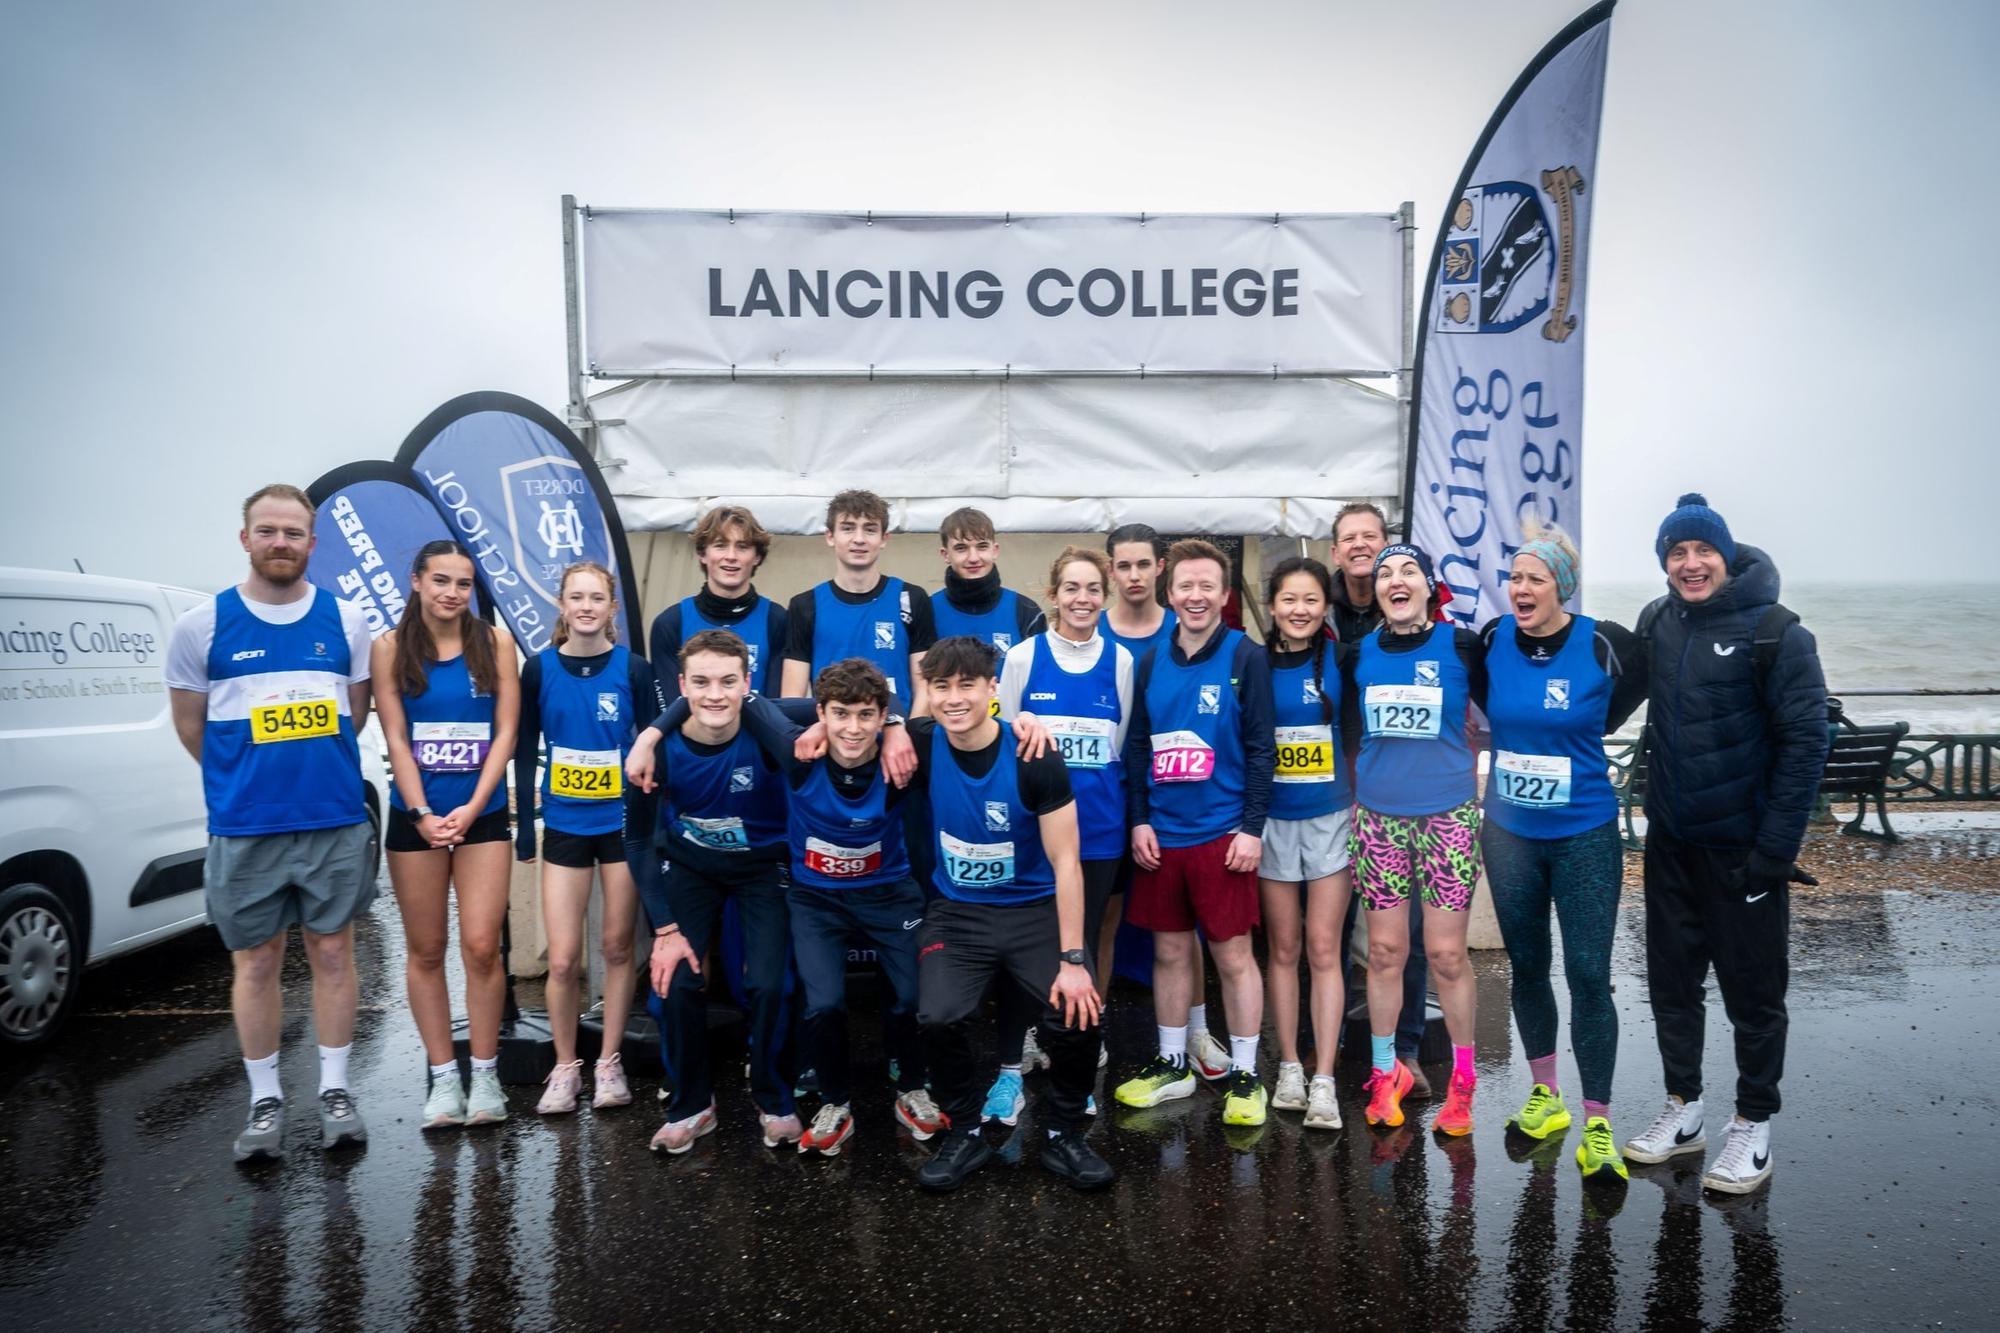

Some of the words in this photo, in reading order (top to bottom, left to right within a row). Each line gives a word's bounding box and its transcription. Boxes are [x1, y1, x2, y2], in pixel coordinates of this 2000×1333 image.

[708, 267, 1004, 319] LANCING
[1026, 267, 1299, 318] COLLEGE
[69, 621, 156, 664] College
[263, 704, 329, 733] 5439
[1373, 705, 1431, 730] 1232
[422, 742, 480, 765] 8421
[1157, 750, 1206, 774] 9712
[559, 767, 612, 791] 3324
[1503, 773, 1560, 800] 1227
[820, 857, 866, 874] 339
[947, 856, 1004, 881] 1229
